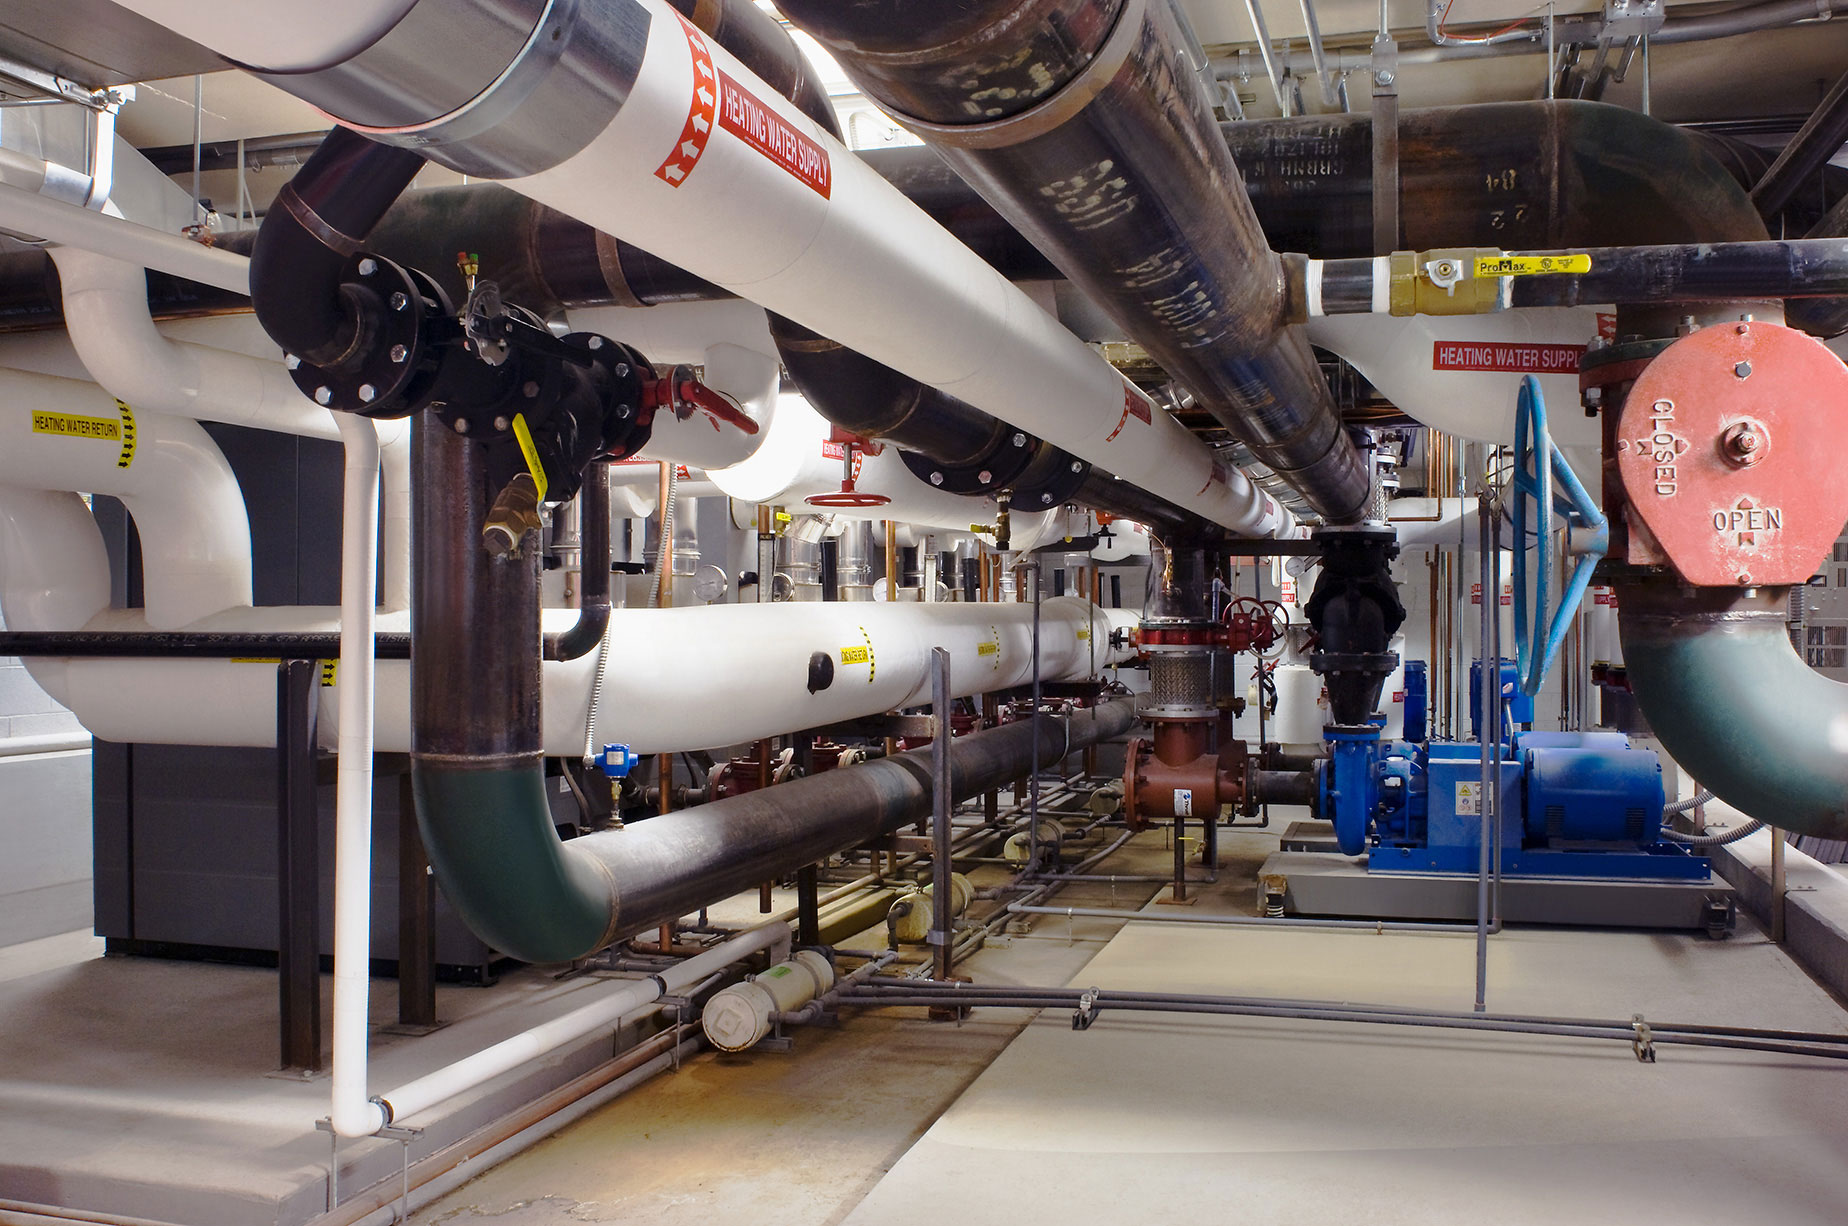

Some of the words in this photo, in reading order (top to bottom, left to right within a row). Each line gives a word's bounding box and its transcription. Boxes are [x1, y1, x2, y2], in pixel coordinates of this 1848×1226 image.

[725, 83, 766, 144] HEATING
[766, 114, 798, 166] WATER
[798, 138, 828, 187] SUPPLY
[1480, 260, 1525, 272] ProMax
[1440, 347, 1492, 366] HEATING
[1495, 348, 1538, 367] WATER
[1541, 350, 1580, 368] SUPPL
[34, 415, 65, 431] HEATING
[66, 419, 90, 434] WATER
[91, 422, 118, 437] RETURN
[1651, 399, 1676, 496] CLOSED
[1713, 509, 1782, 531] OPEN
